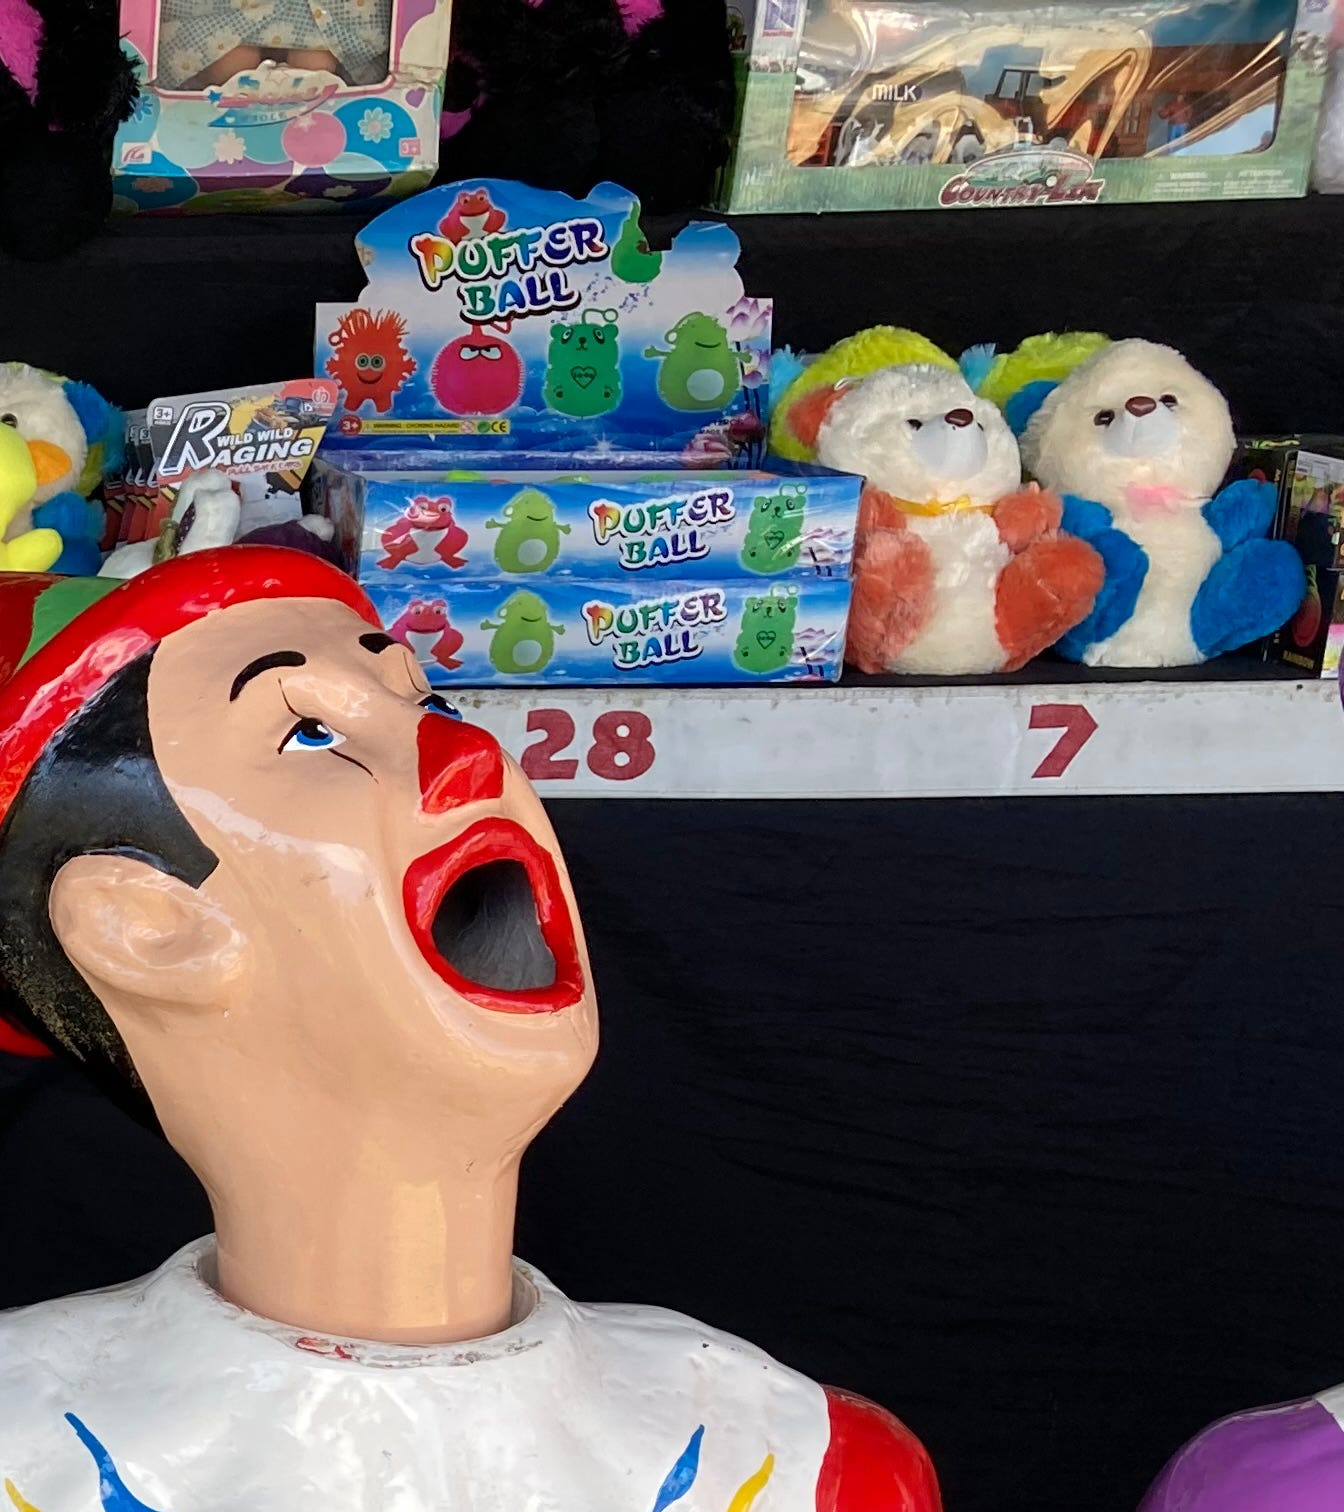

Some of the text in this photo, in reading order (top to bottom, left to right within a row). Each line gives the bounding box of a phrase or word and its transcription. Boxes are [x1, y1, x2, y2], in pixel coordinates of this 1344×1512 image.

[872, 83, 918, 101] MILK
[410, 217, 608, 287] PUFFER
[462, 266, 578, 320] BALL
[217, 427, 294, 448] WILD WILD
[591, 489, 733, 540] PUFFER
[623, 529, 708, 565] BALL
[584, 590, 725, 640] PUFFER
[618, 629, 700, 665] BALL
[519, 707, 656, 781] 28
[1028, 703, 1098, 779] 7
